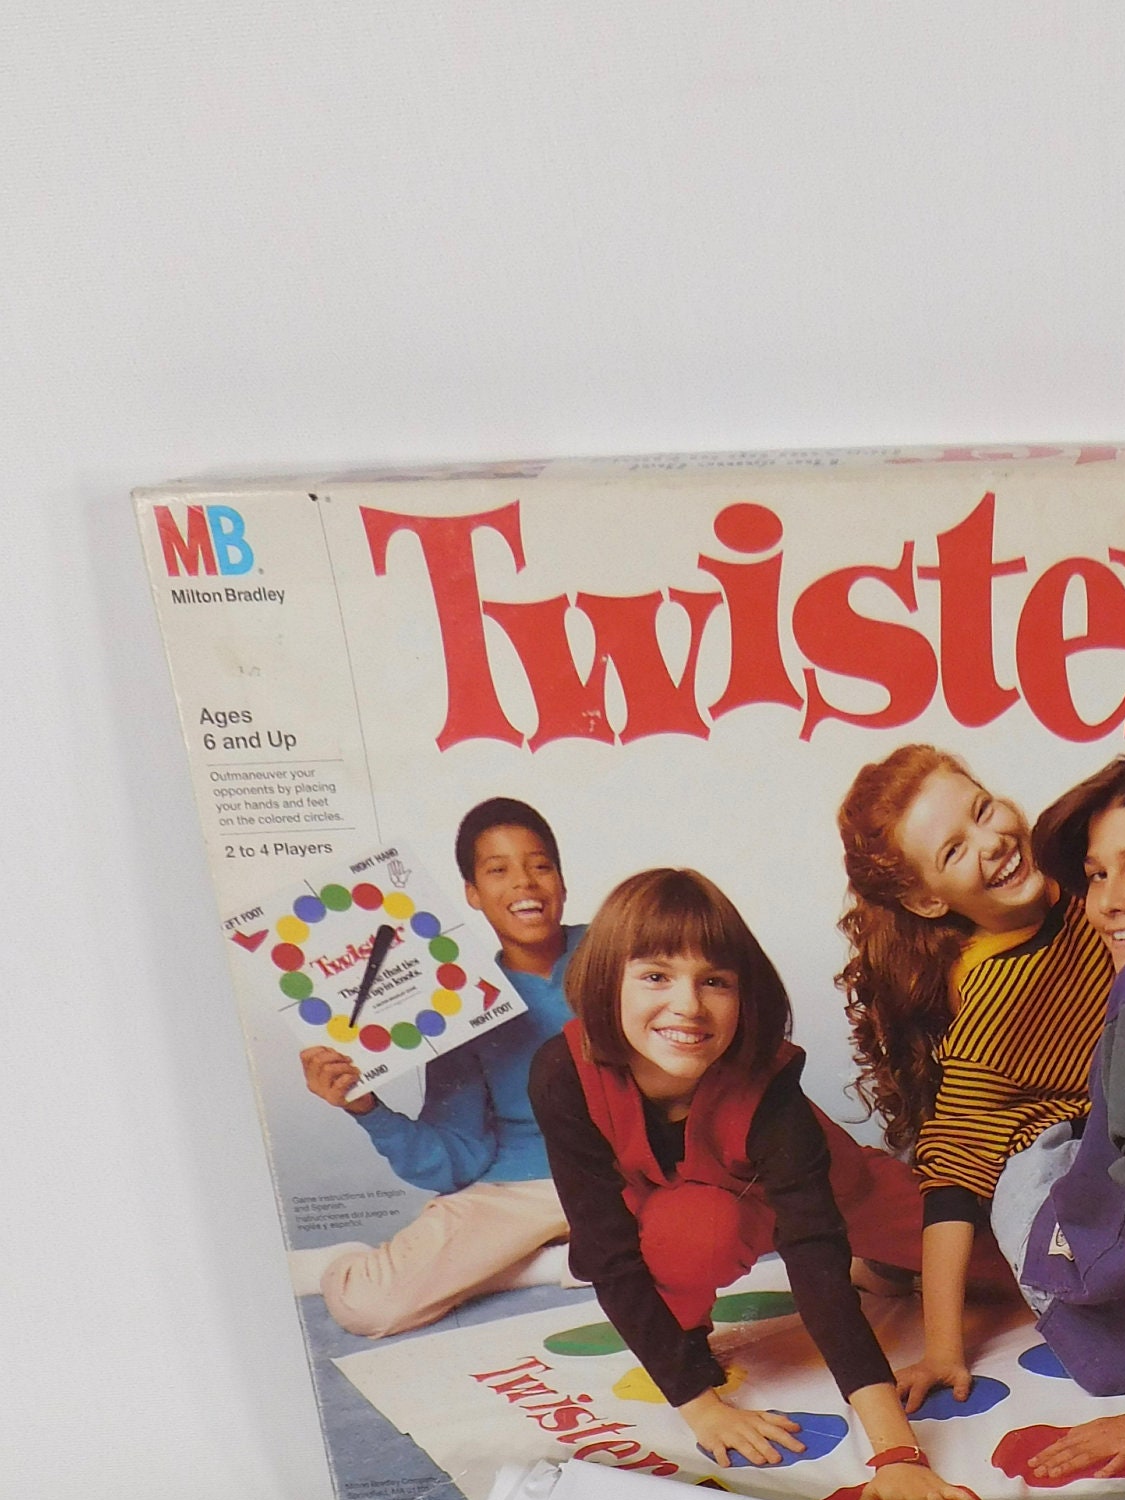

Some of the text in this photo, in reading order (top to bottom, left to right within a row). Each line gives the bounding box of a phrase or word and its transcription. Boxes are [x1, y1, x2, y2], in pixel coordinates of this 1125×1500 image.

[171, 586, 285, 604] Milton Bradley
[200, 707, 253, 728] Ages
[203, 730, 297, 751] 6 and Up
[210, 769, 315, 782] Outmaneuver your
[213, 783, 336, 798] opponents by placing
[215, 797, 329, 813] your hands and feet
[219, 812, 343, 826] on the colored circles.
[225, 843, 333, 858] 2 to 4 Players
[240, 906, 264, 922] FOOT
[492, 1001, 513, 1017] FOOT
[467, 1356, 679, 1476] Twister
